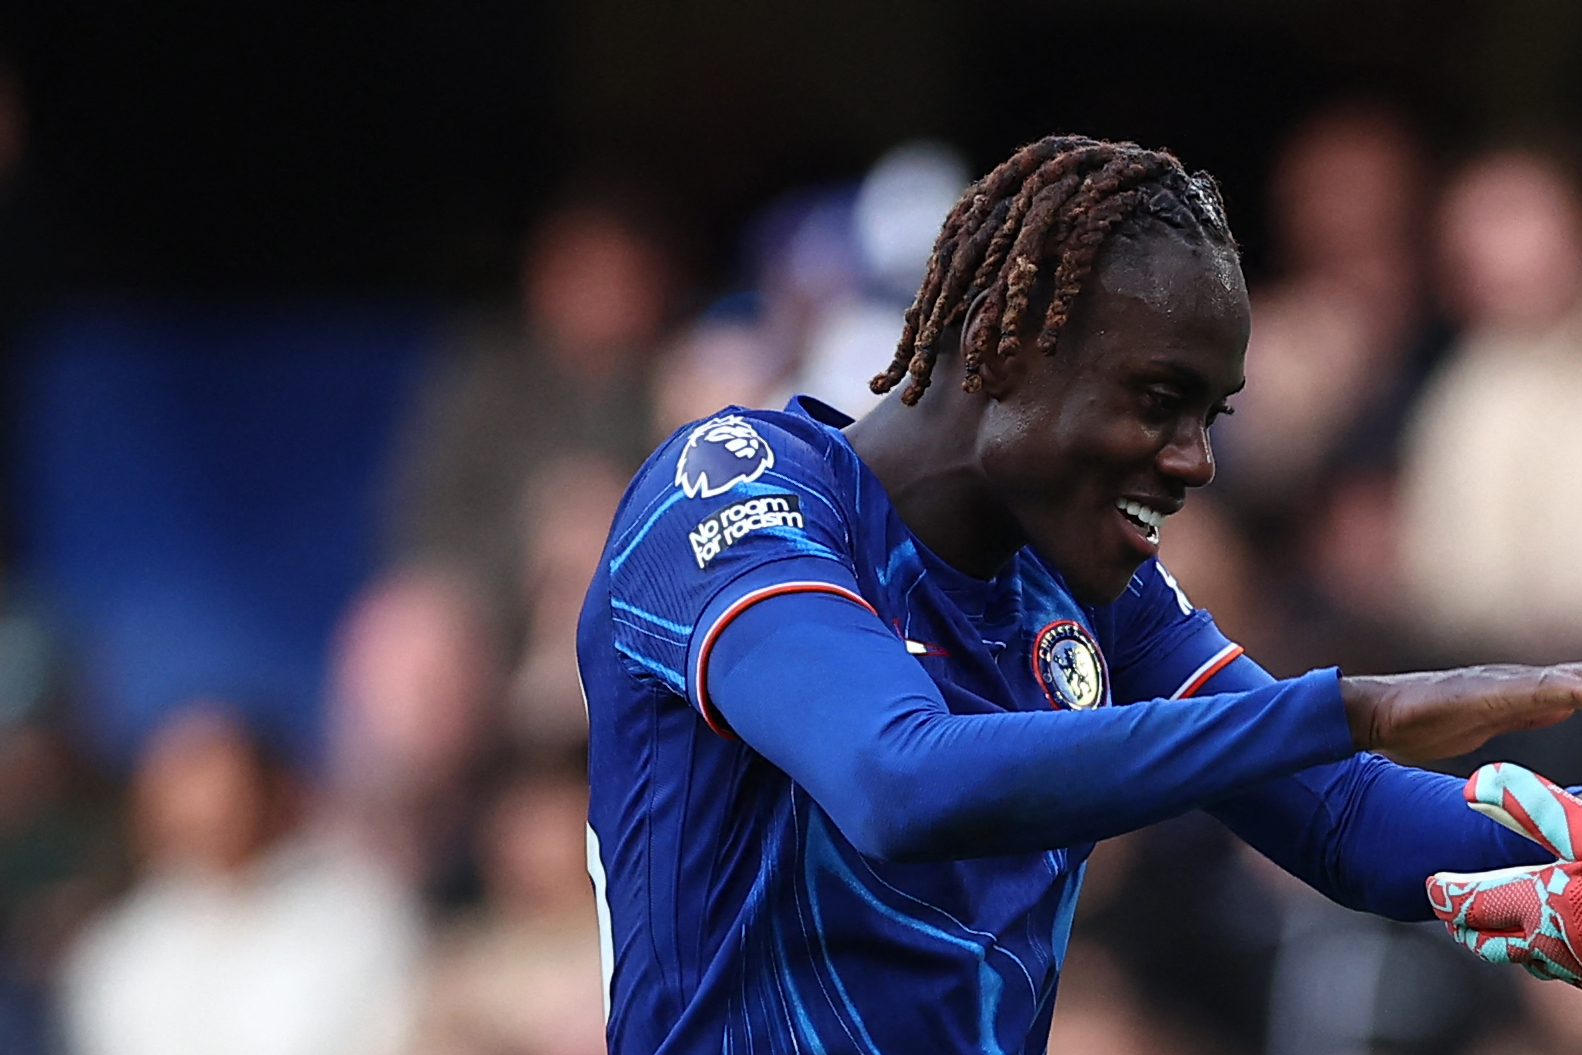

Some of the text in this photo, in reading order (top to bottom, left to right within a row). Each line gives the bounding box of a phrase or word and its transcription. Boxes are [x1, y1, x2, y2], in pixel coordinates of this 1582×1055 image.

[689, 498, 790, 553] No room
[696, 511, 804, 569] for racism
